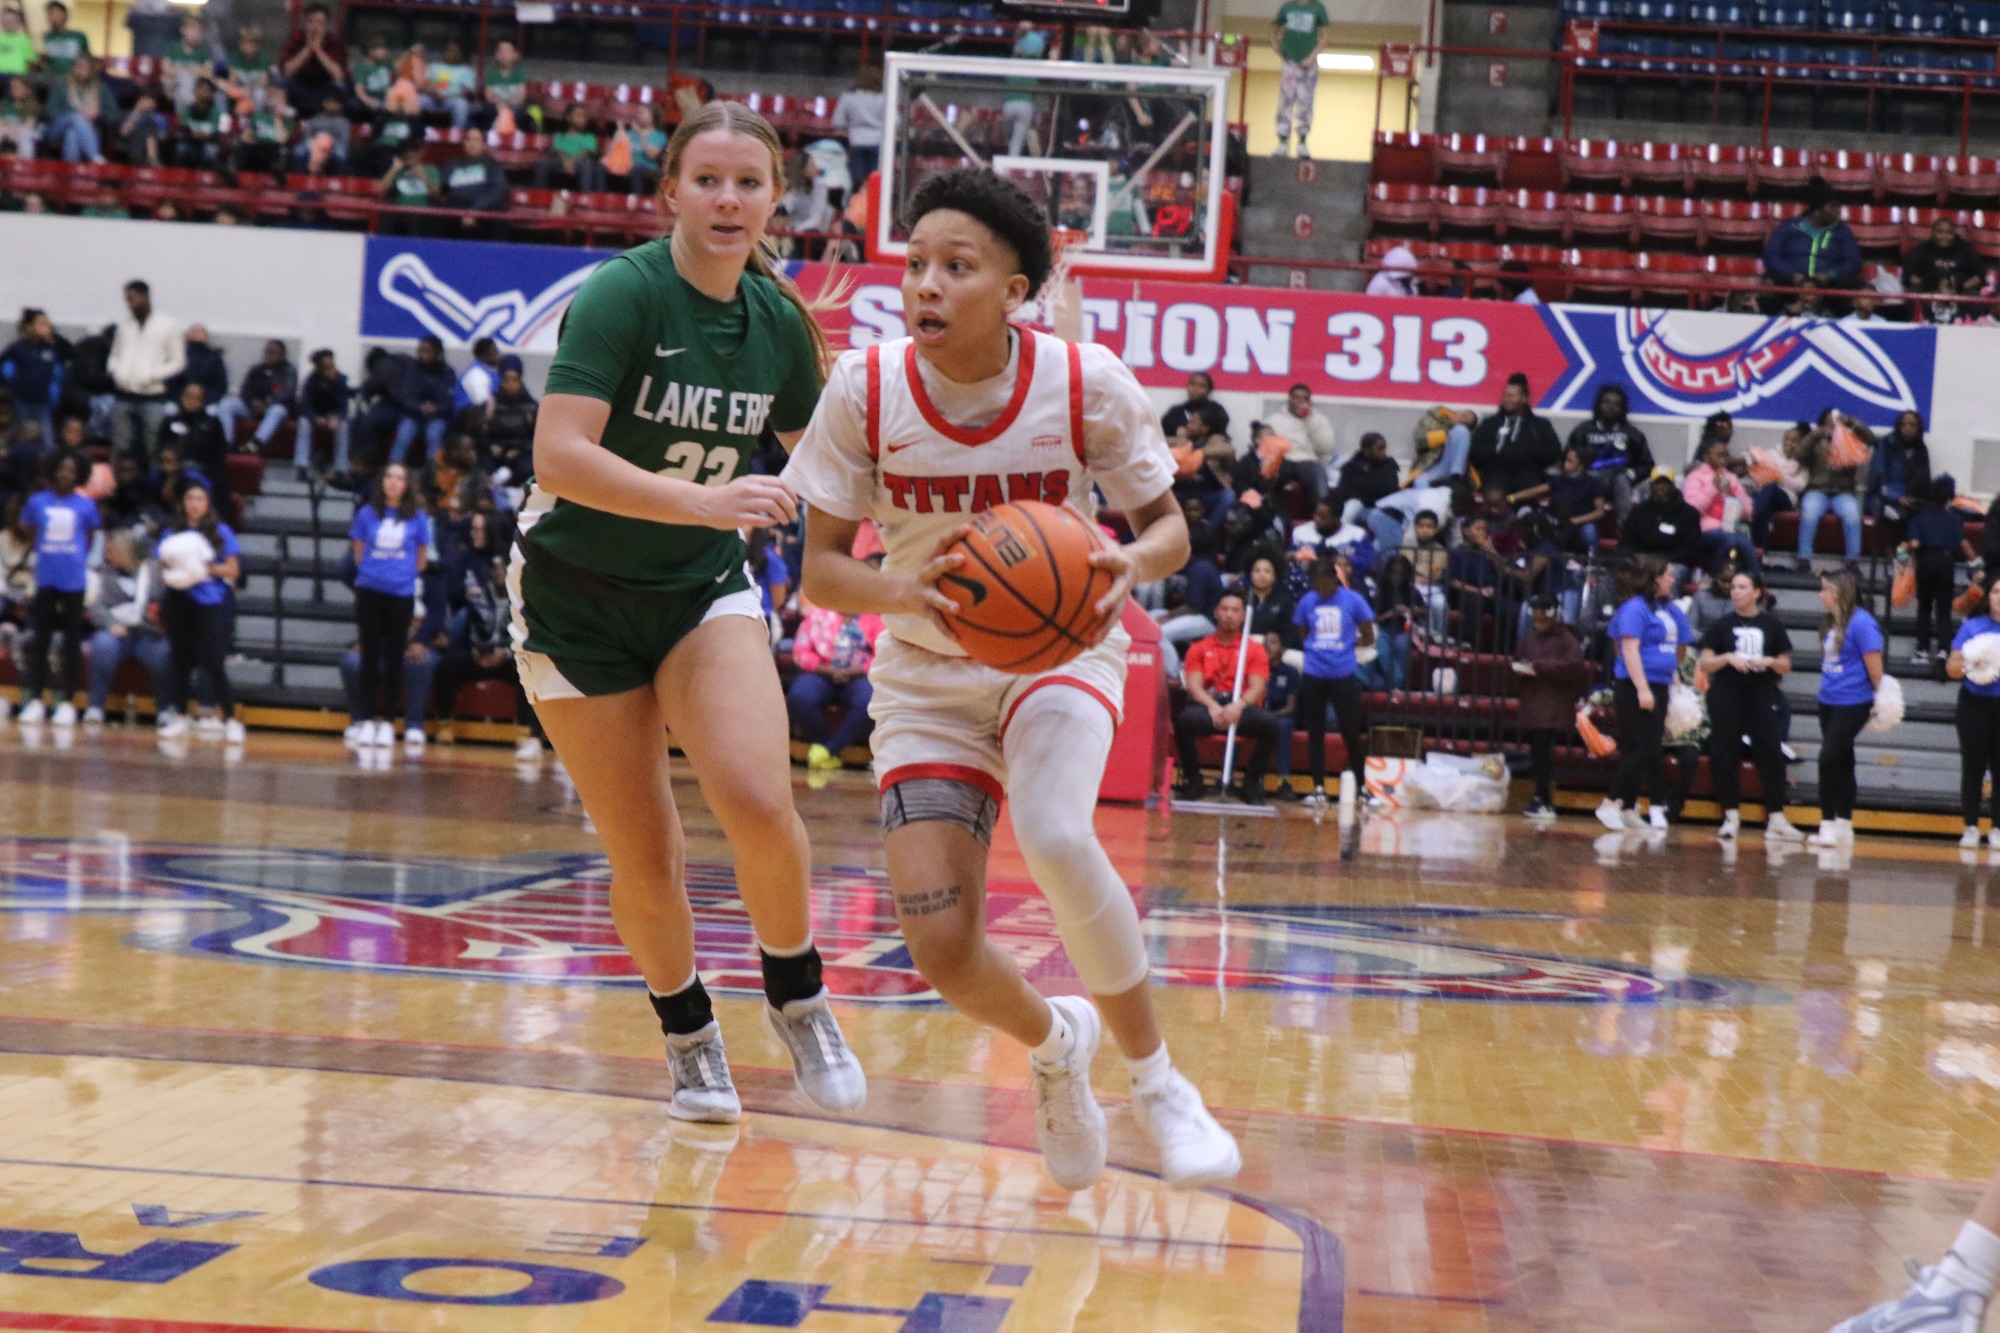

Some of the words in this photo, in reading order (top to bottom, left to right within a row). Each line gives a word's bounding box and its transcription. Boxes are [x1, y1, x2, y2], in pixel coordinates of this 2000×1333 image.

[849, 284, 1296, 376] STION
[1324, 311, 1490, 388] 313
[633, 375, 723, 431] LAKE
[883, 470, 1069, 513] TITANS
